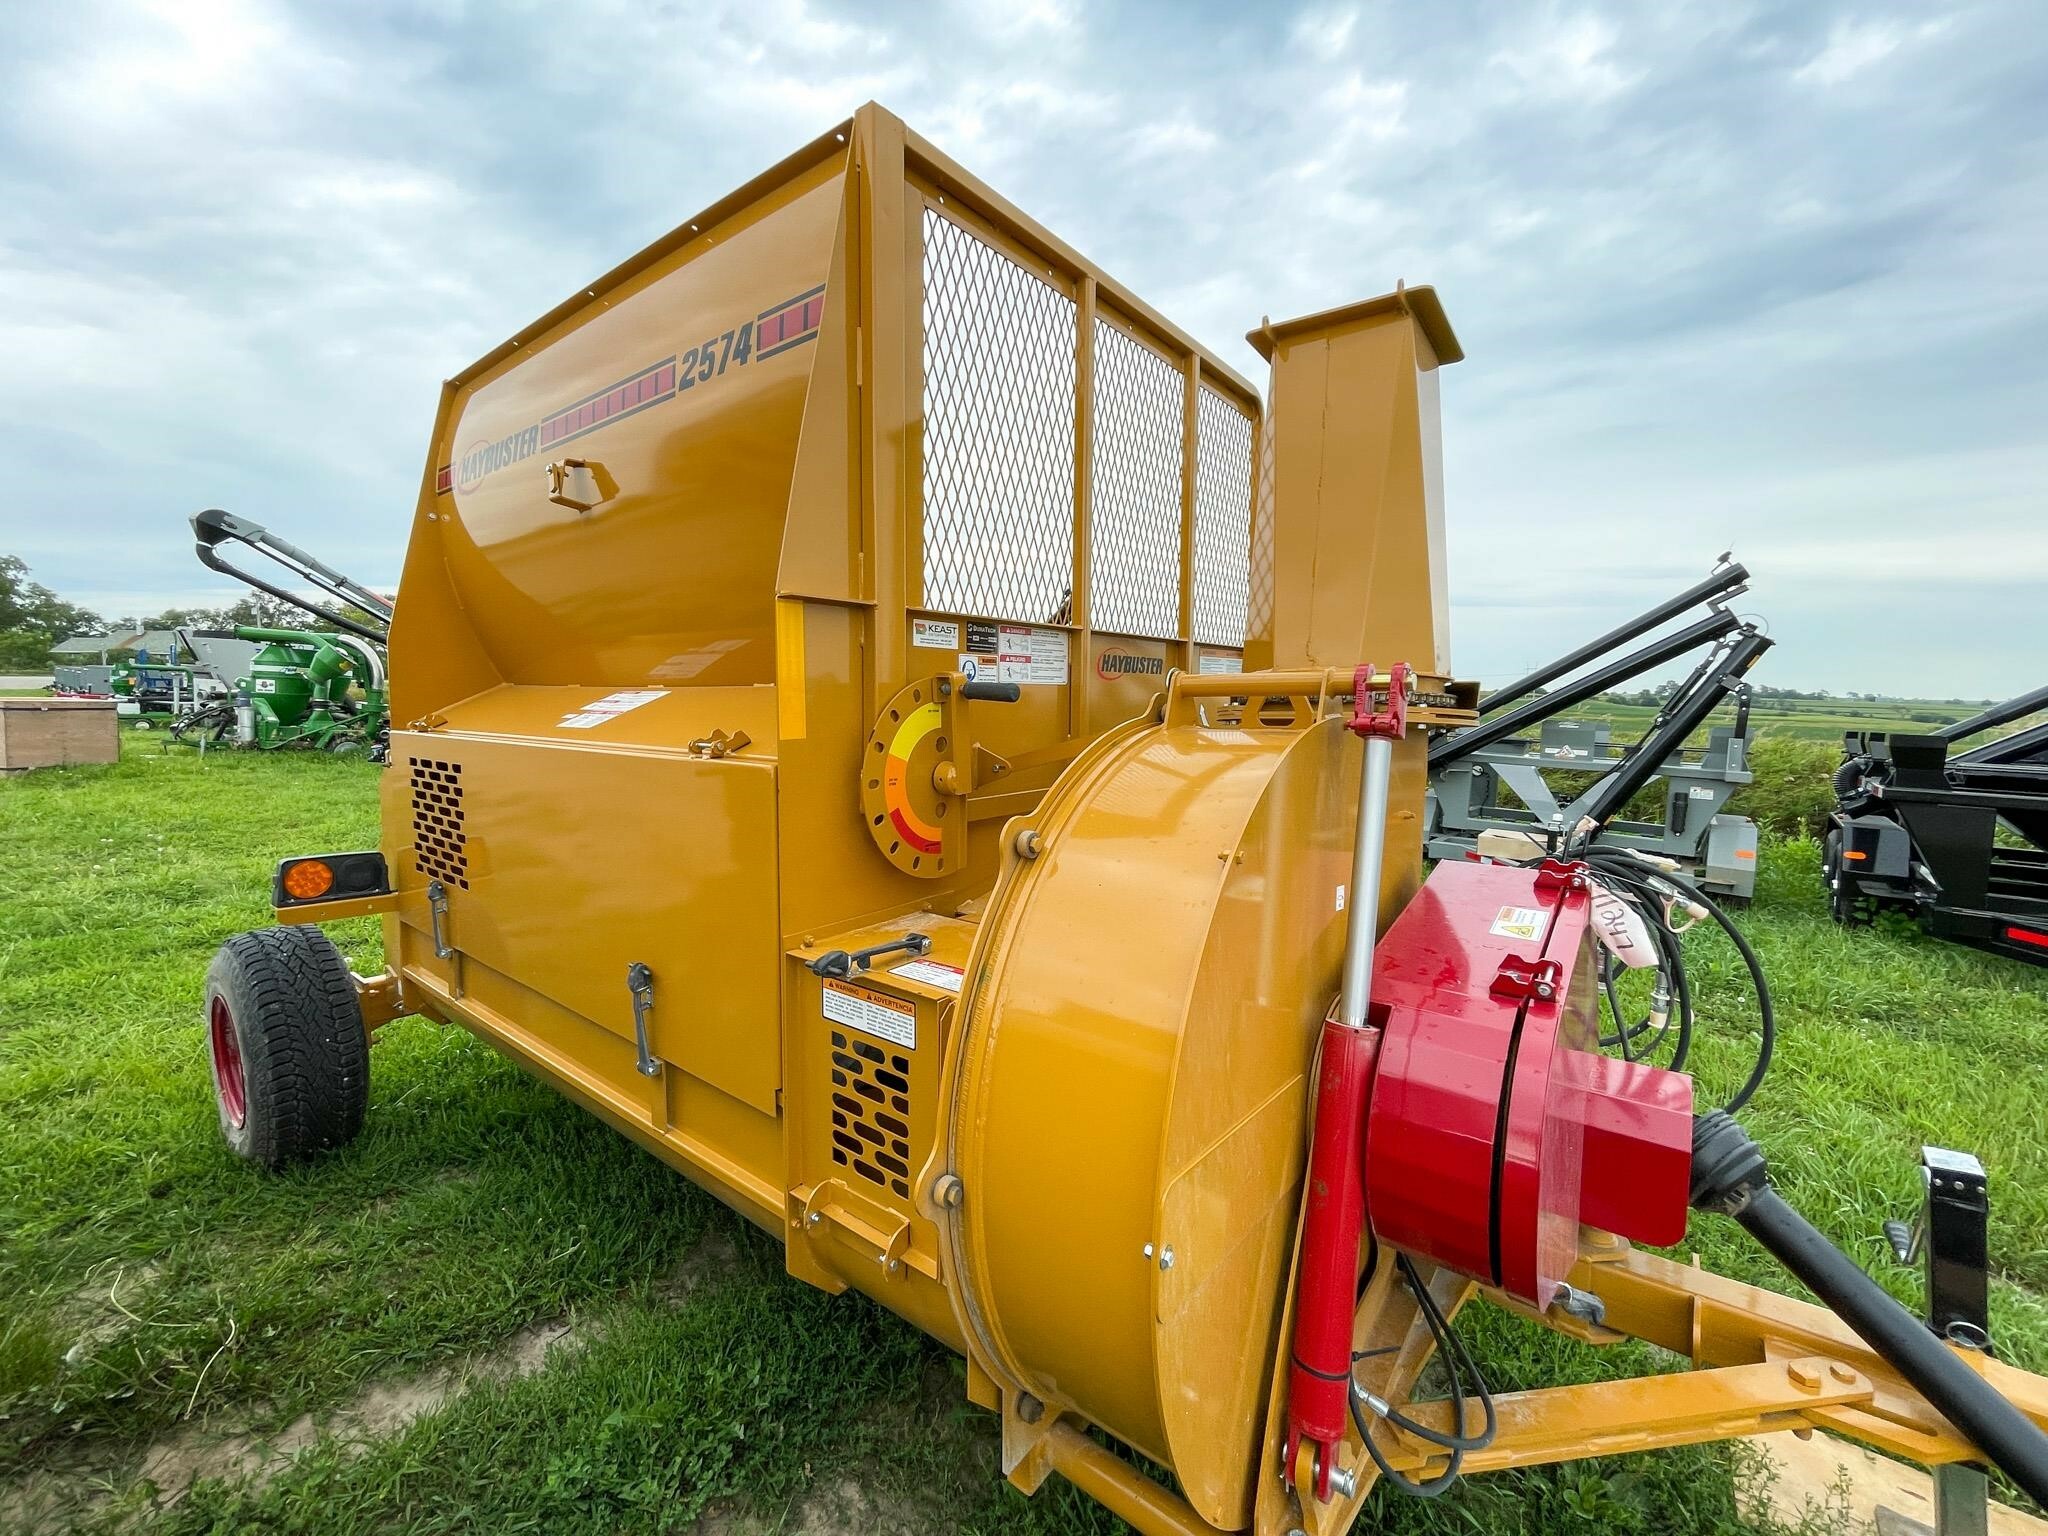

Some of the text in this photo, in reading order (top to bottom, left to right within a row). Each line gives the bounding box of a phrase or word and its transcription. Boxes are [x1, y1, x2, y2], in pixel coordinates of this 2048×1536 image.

[678, 320, 755, 392] 2574
[459, 424, 540, 485] HAYBUSTER
[928, 624, 957, 634] KEAST
[1101, 653, 1164, 675] HAYBUSTER
[835, 982, 860, 996] WARNING
[873, 995, 914, 1014] ADVERTENCIA
